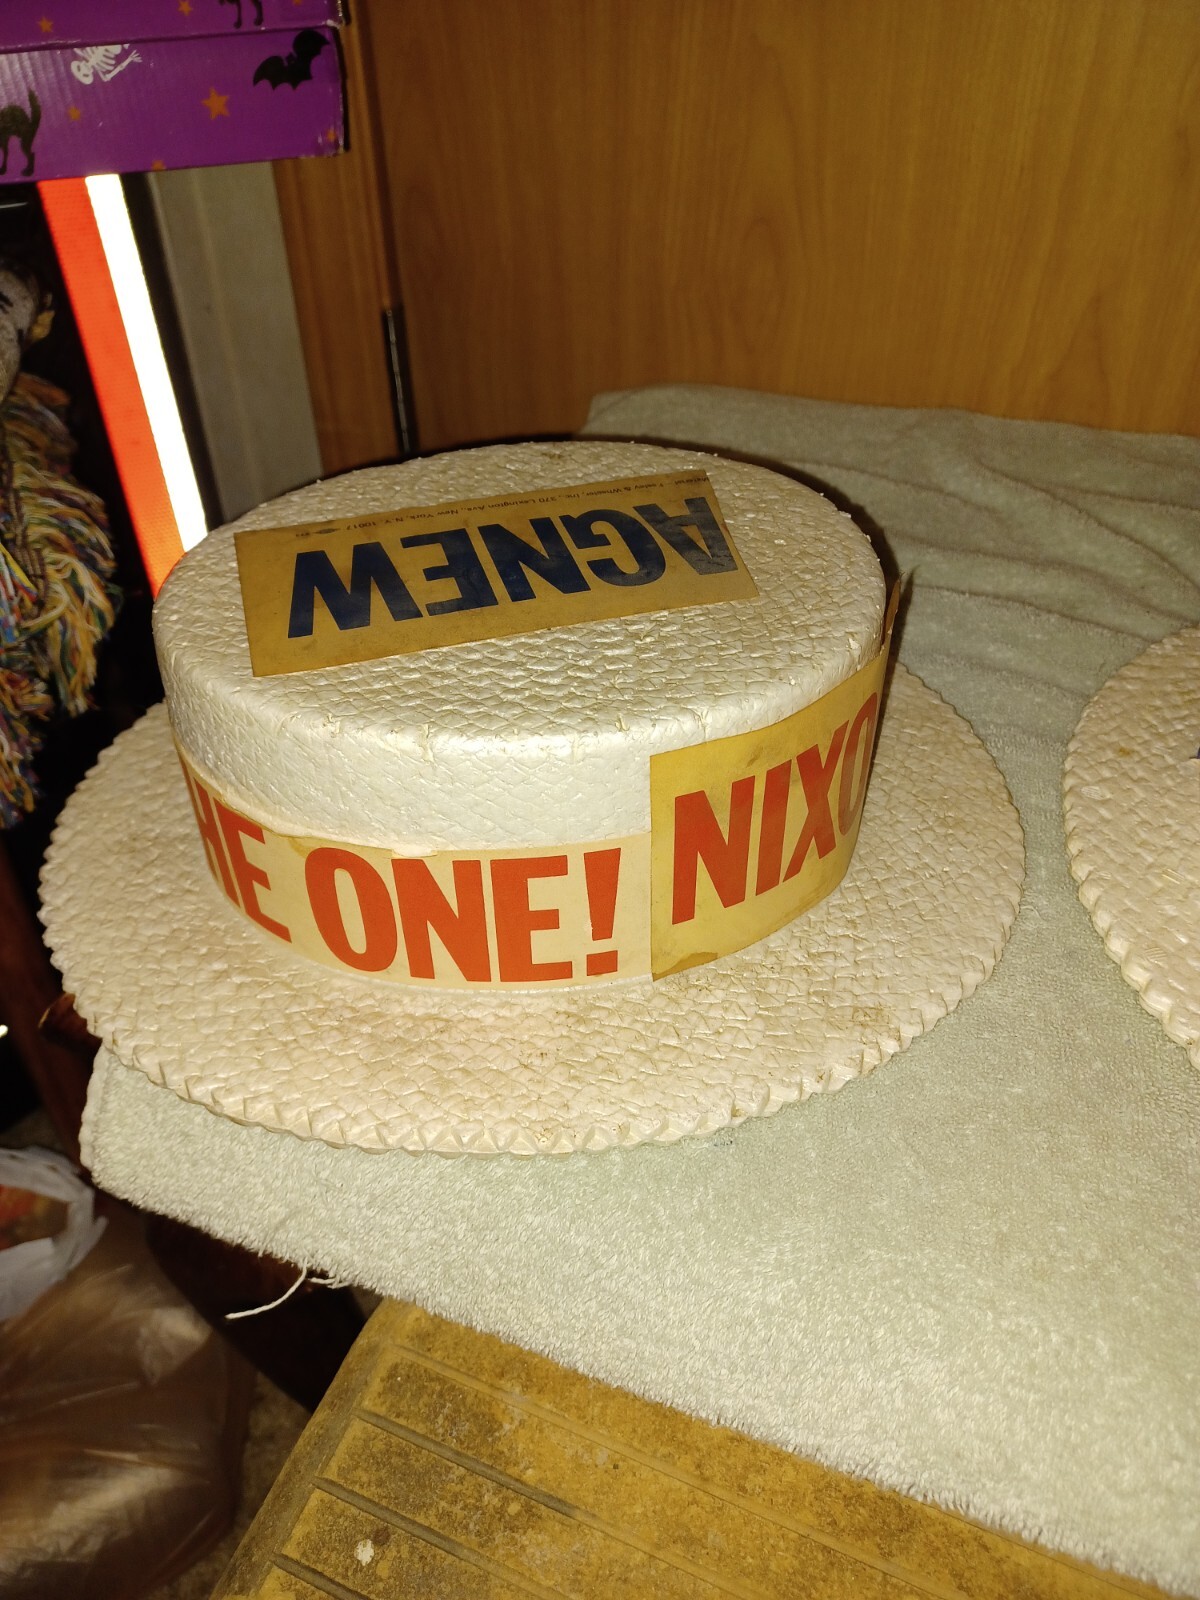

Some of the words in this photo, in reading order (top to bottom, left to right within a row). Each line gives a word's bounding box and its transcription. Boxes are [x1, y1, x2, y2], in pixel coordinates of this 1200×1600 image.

[487, 498, 536, 509] Lexington
[436, 508, 459, 516] New
[346, 521, 377, 531] 10017
[288, 496, 739, 638] AGNEW
[305, 846, 622, 983] ONE!
